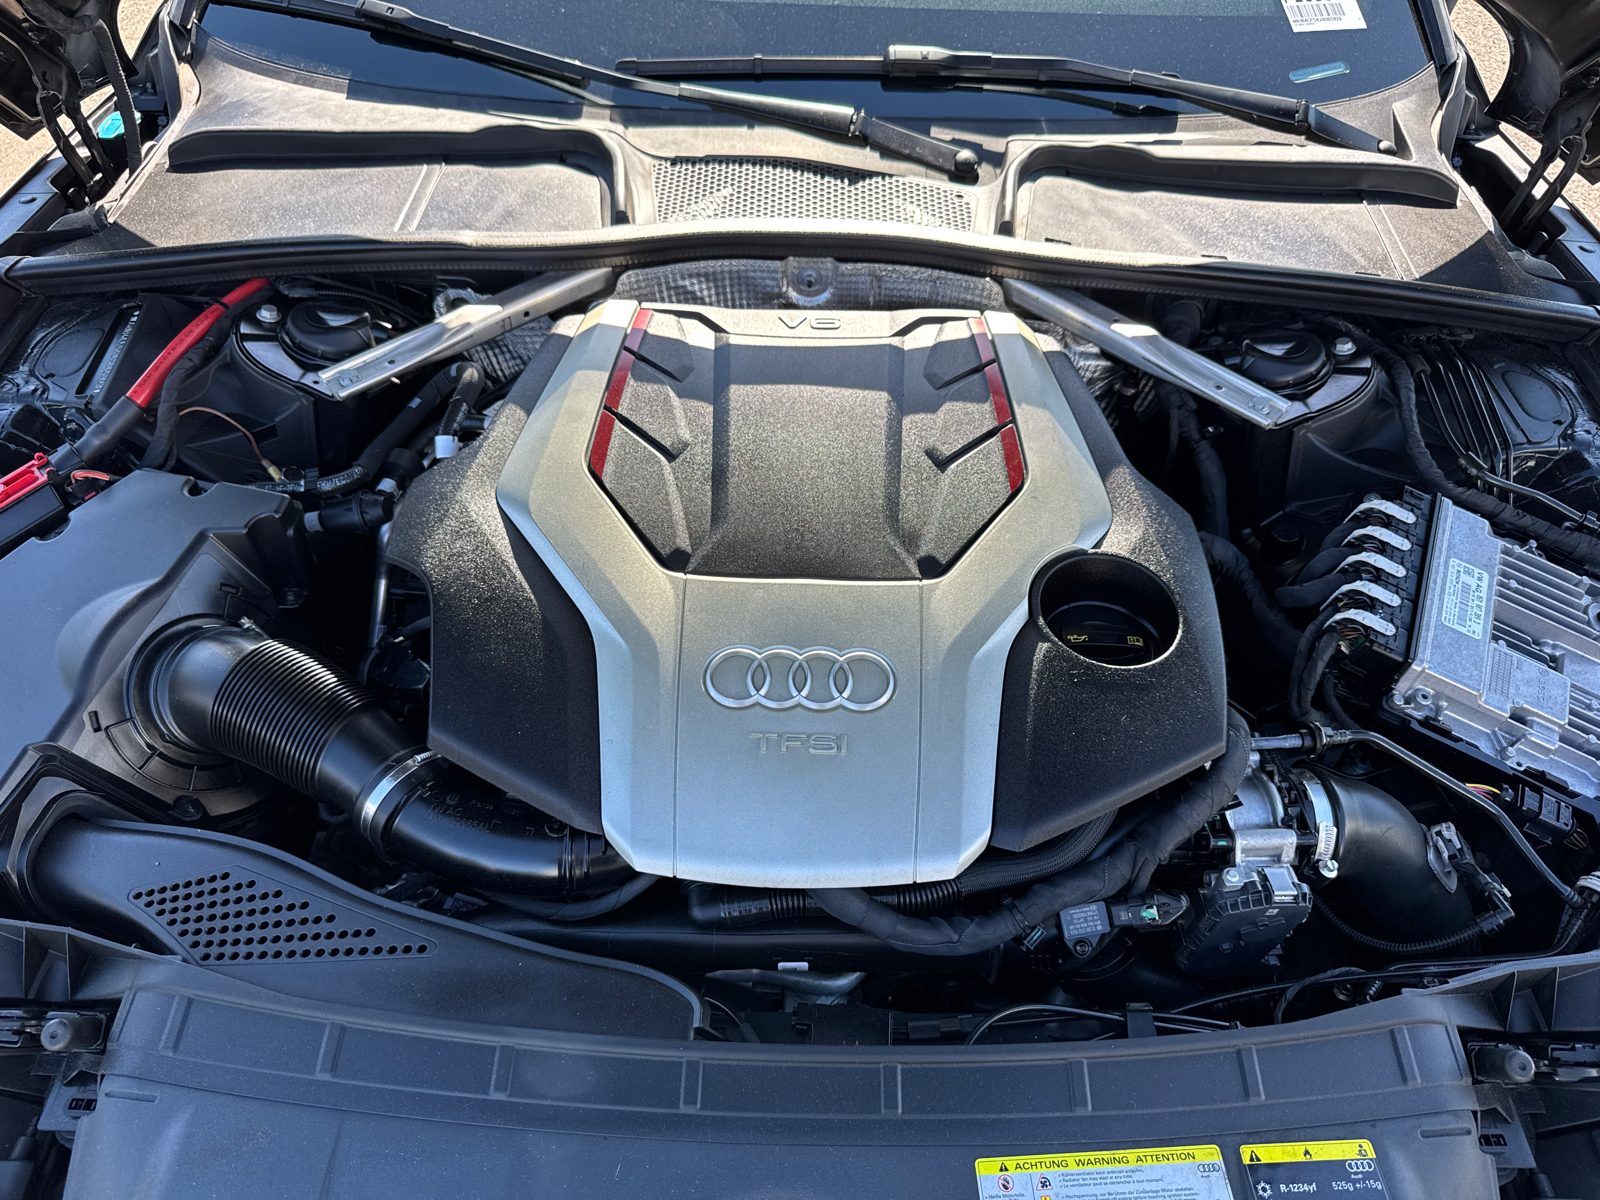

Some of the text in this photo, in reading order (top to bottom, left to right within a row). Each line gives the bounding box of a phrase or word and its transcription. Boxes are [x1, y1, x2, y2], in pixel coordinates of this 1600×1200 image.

[778, 316, 841, 330] V6
[750, 732, 848, 755] TFSI
[1014, 1152, 1196, 1171] ACHTUNG WARNING ATTENTION
[1279, 1180, 1382, 1193] R-1234yf 525g +/-15g
